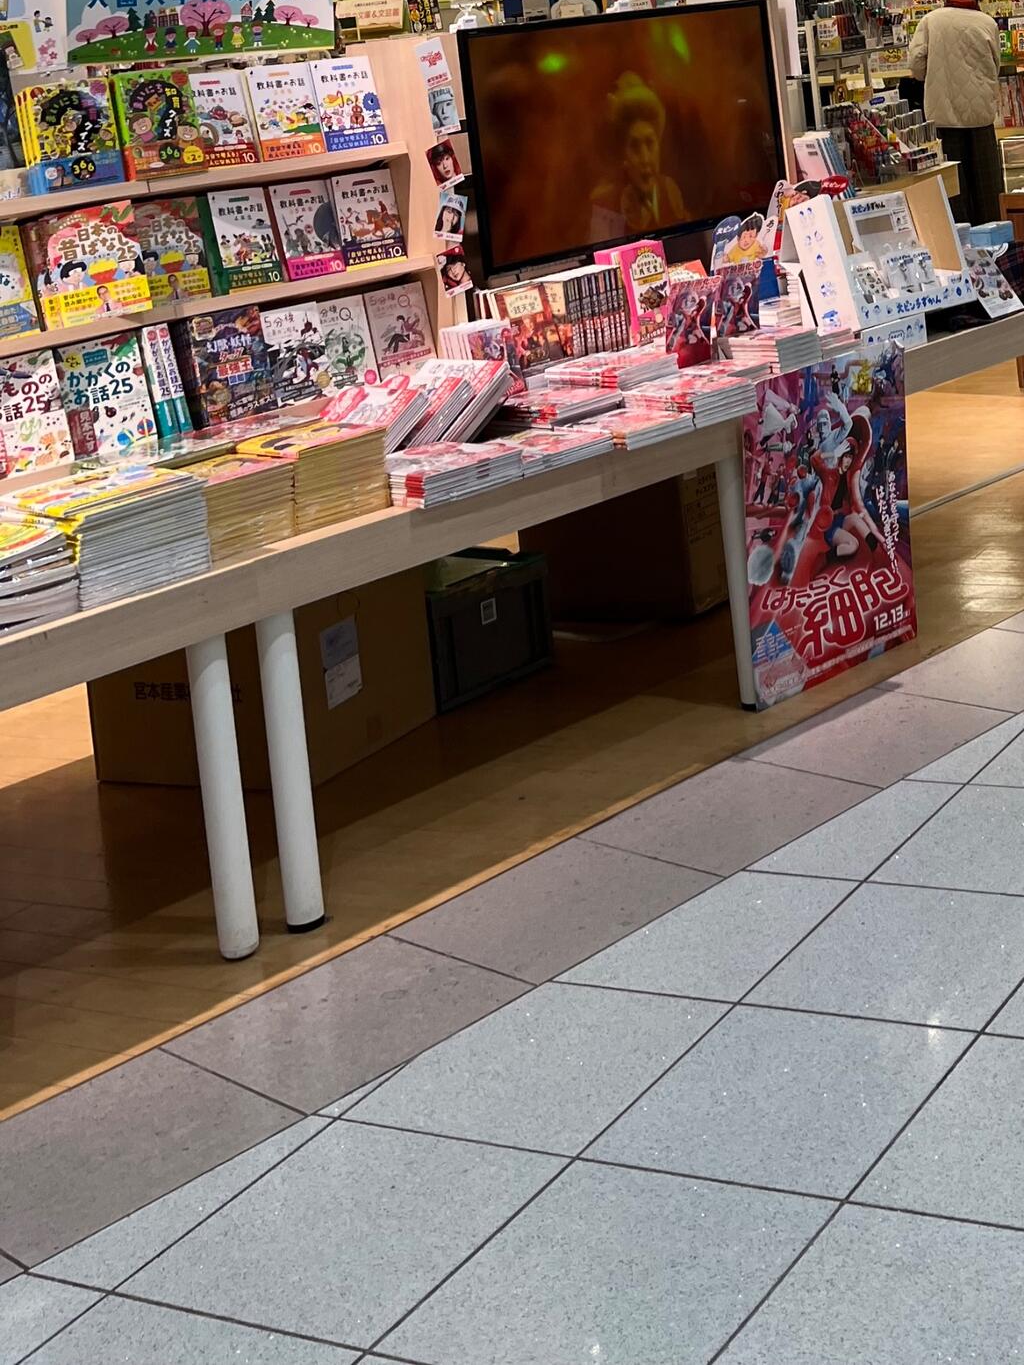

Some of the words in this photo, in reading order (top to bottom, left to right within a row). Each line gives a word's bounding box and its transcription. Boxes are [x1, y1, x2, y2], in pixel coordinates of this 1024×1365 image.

[256, 78, 305, 90] 教科書のお話
[321, 71, 369, 83] 教科書のお話
[160, 147, 180, 160] 366
[72, 161, 95, 175] 366
[342, 185, 389, 199] 教科書のお話
[218, 205, 264, 215] 教科書のお話
[280, 196, 326, 209] 教科書のお話
[77, 223, 118, 242] 日本の
[151, 218, 185, 232] 日本の
[58, 233, 129, 261] 昔ばなし
[116, 245, 138, 261] 25
[183, 239, 201, 253] 25
[896, 295, 941, 314] 大ピンチずかん
[264, 314, 296, 329] 5分後
[67, 361, 131, 387] かがくの
[217, 358, 254, 378] 最強王
[74, 377, 133, 405] お話25
[761, 566, 850, 616] はたらく
[795, 566, 909, 660] 細胞
[873, 604, 905, 632] 12.13
